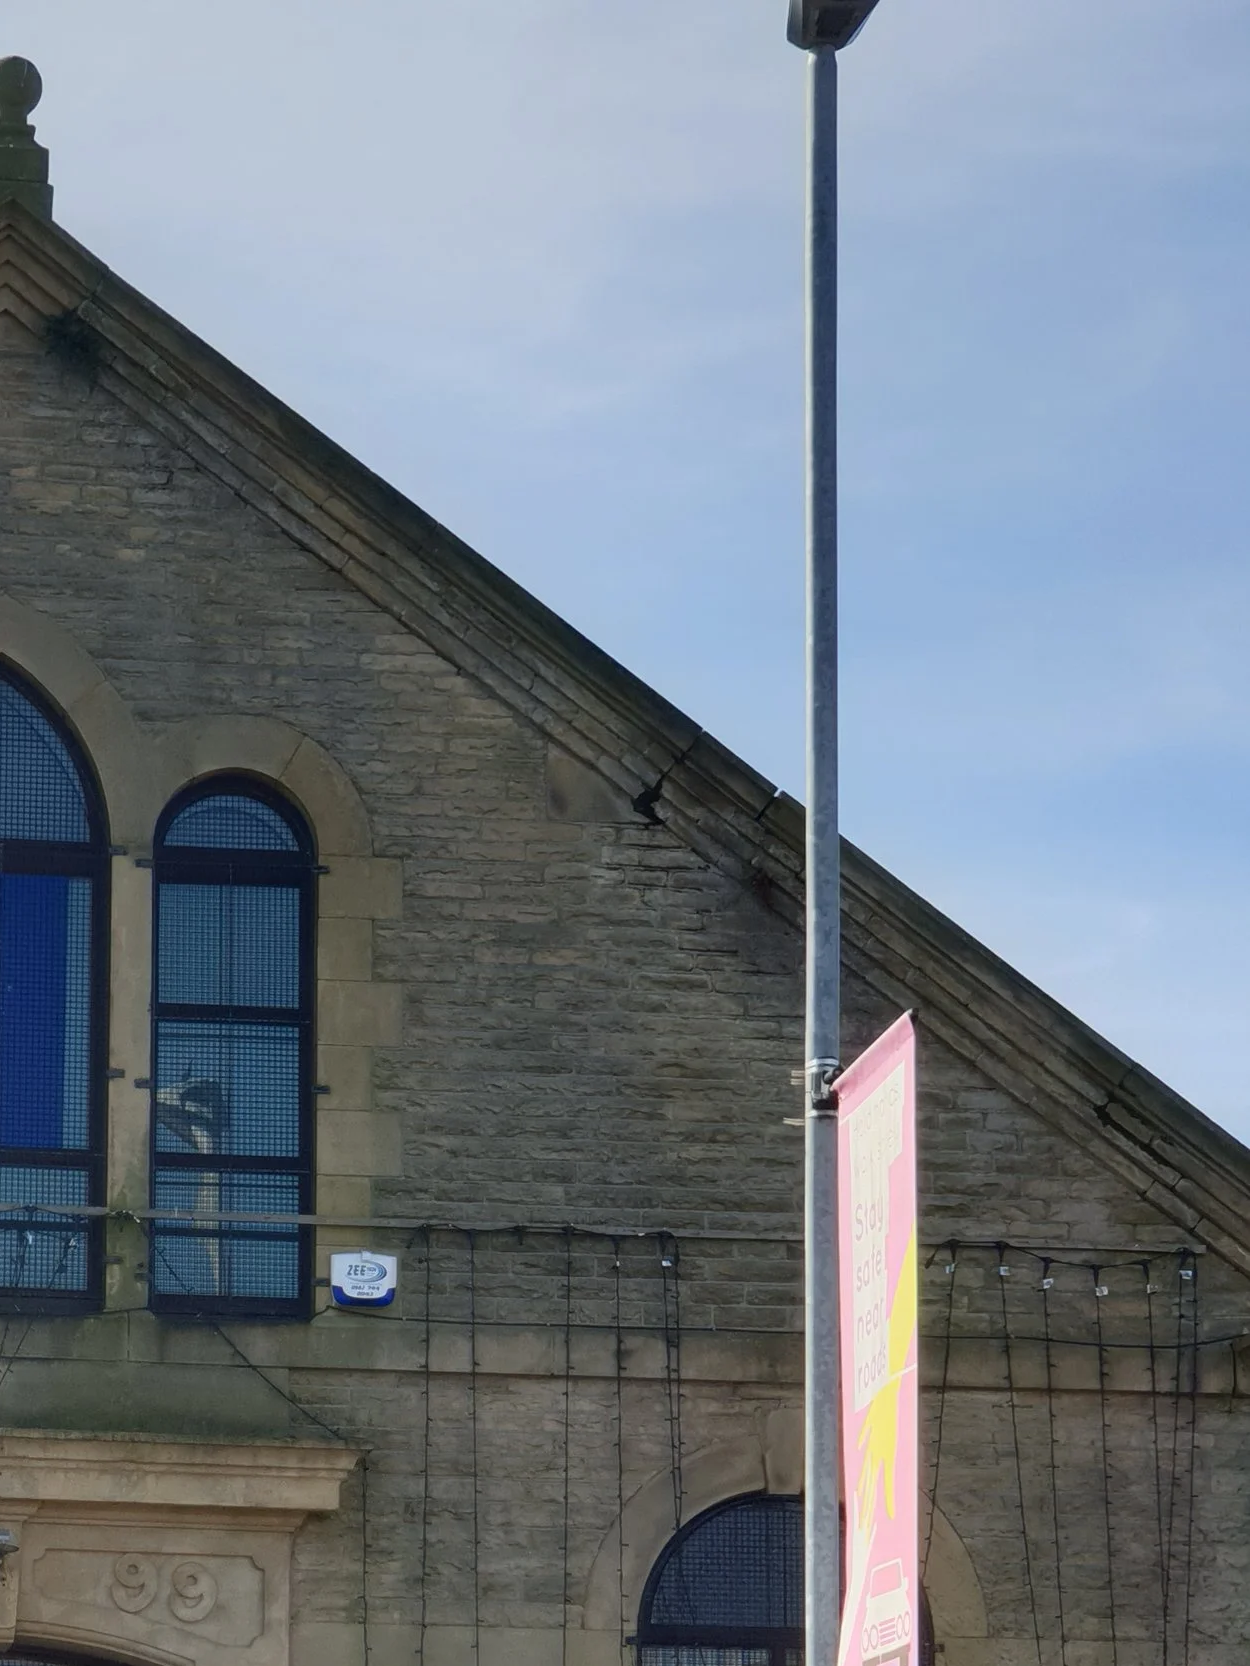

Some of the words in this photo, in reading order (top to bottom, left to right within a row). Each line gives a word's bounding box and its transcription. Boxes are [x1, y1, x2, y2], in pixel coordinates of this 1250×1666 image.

[855, 1196, 883, 1242] Stay
[347, 1265, 366, 1276] ZEE
[856, 1243, 882, 1292] safe
[857, 1299, 884, 1344] near
[857, 1343, 887, 1393] roads
[109, 1552, 219, 1623] 99
